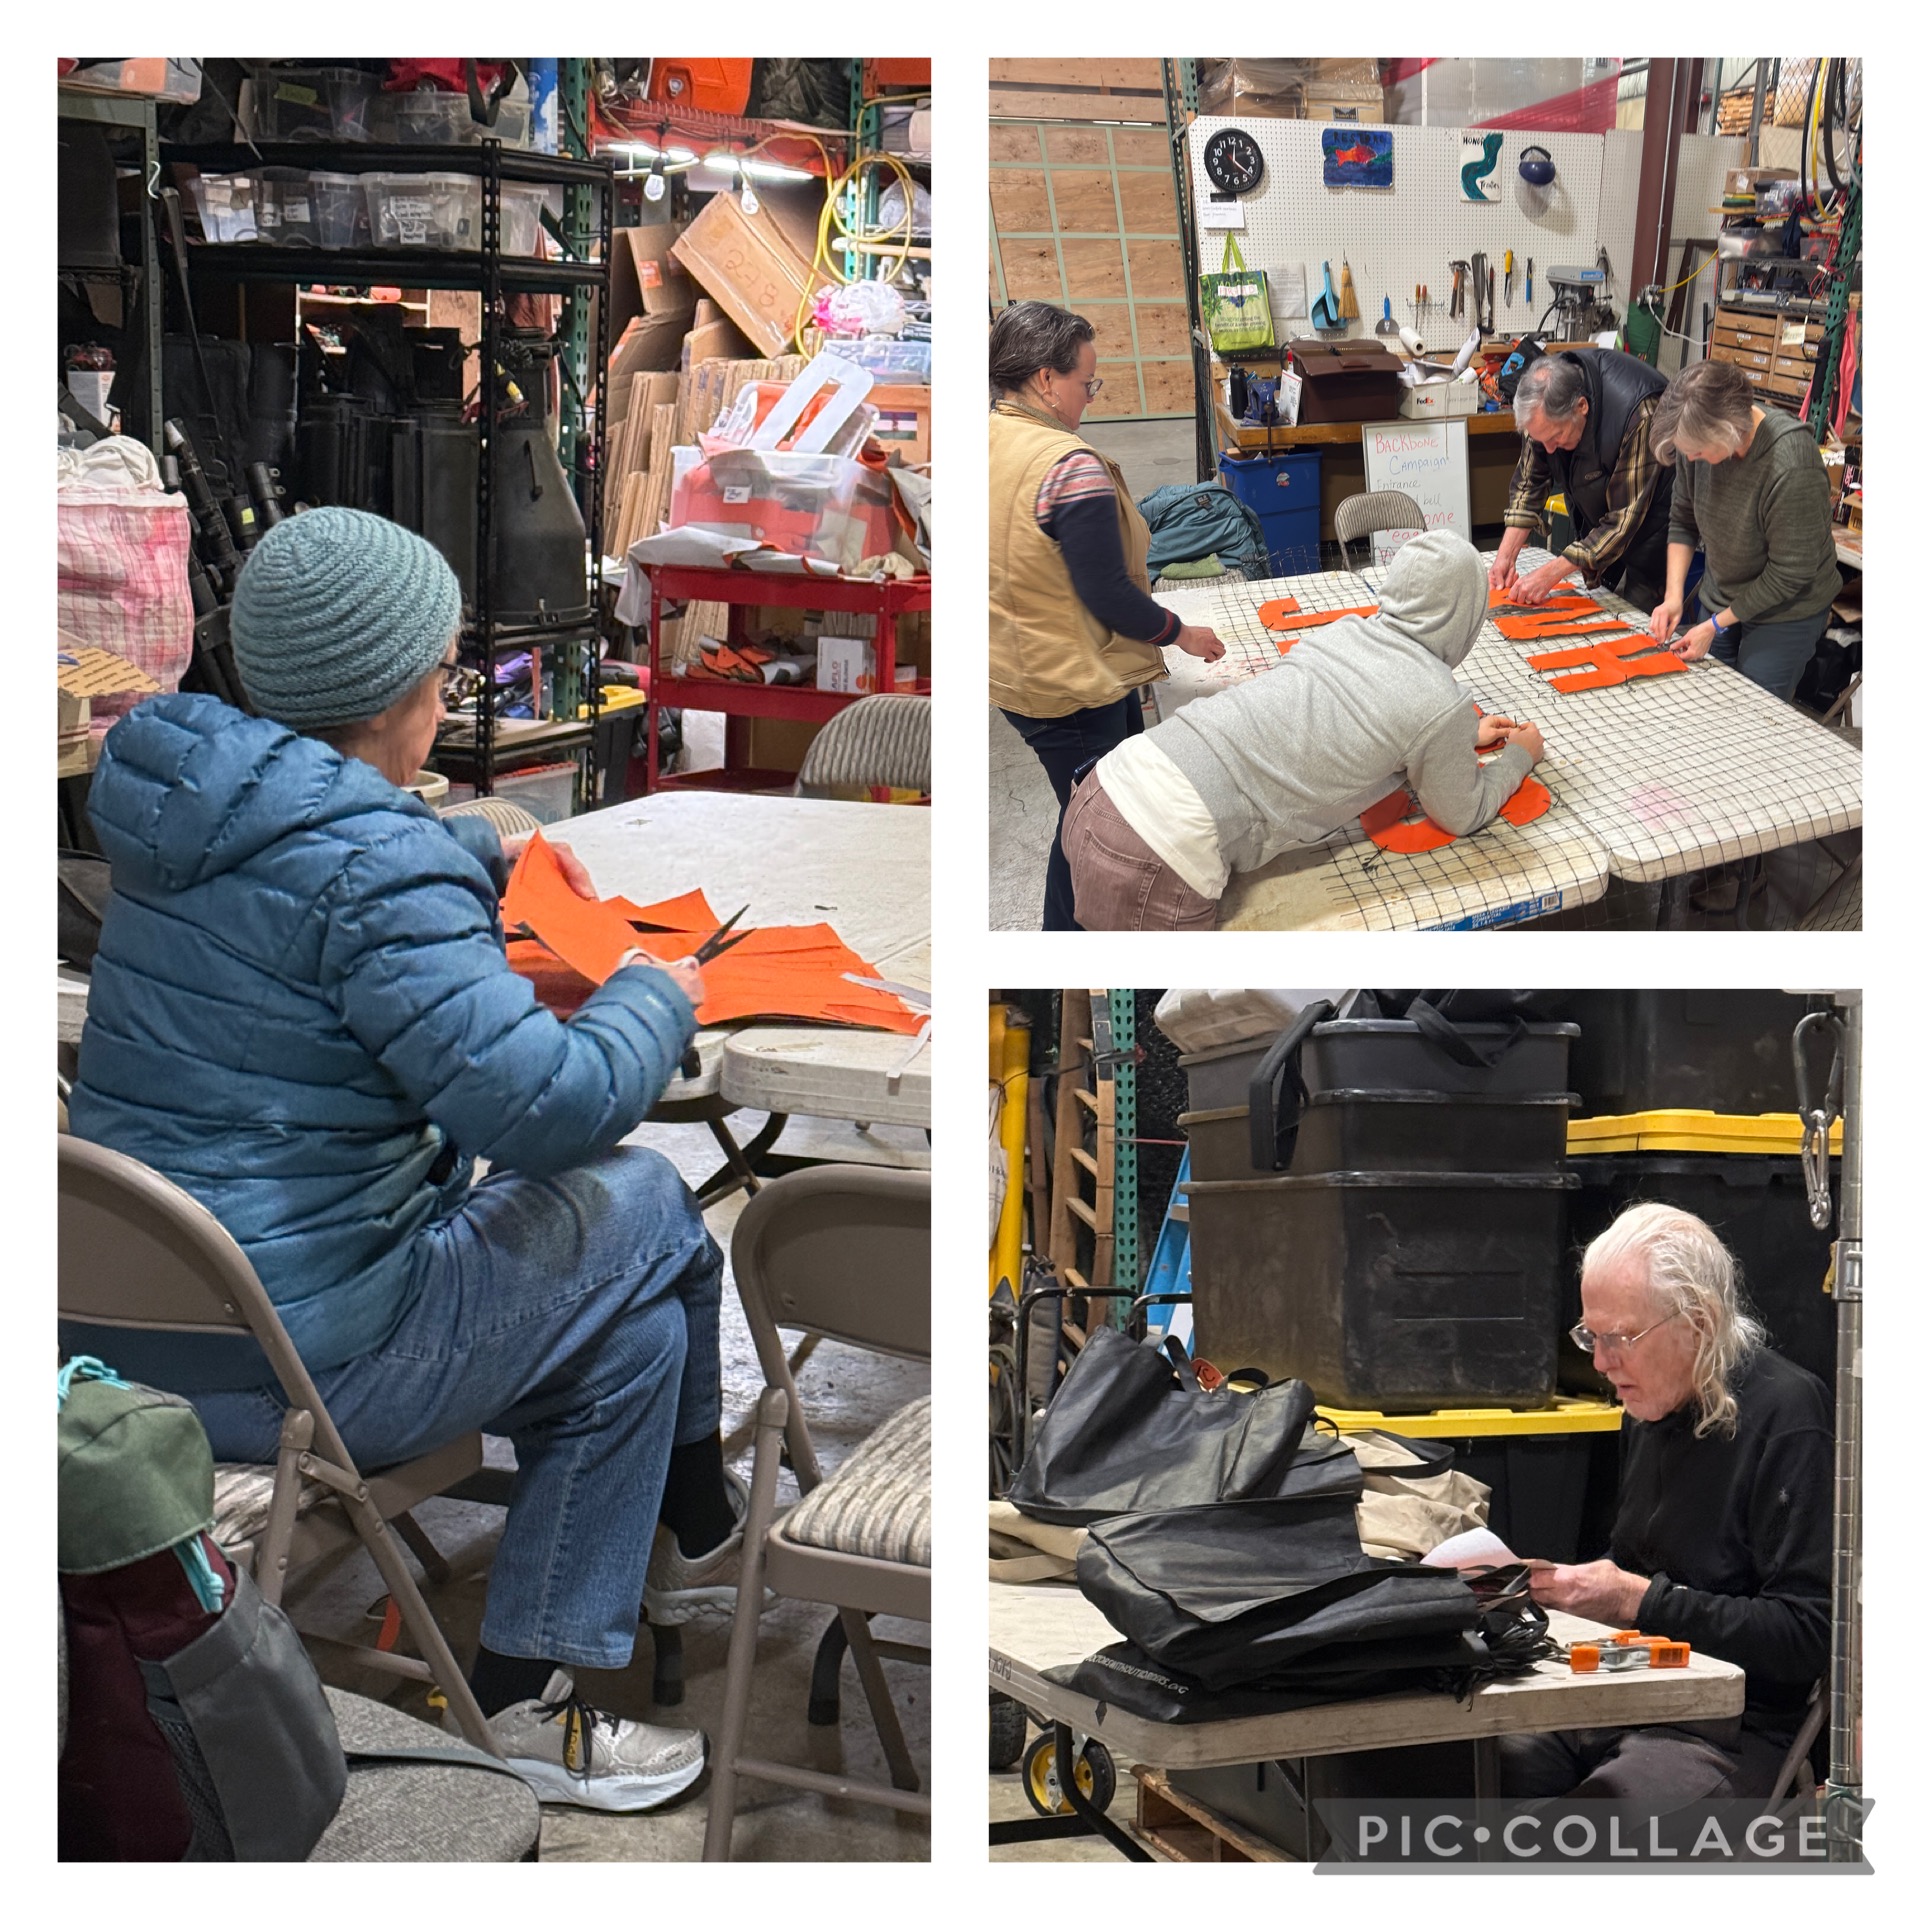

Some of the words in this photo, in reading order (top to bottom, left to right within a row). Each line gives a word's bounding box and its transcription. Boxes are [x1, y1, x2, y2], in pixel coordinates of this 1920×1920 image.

[1219, 140, 1226, 149] 11
[1227, 136, 1236, 146] 12
[1239, 139, 1243, 148] 1
[1214, 147, 1222, 157] 10
[1246, 146, 1251, 156] 2
[1213, 157, 1218, 166] 9
[1250, 156, 1255, 165] 3
[1216, 166, 1222, 176] 8
[1248, 166, 1253, 175] 4
[1224, 174, 1230, 183] 7
[1233, 176, 1240, 185] 6
[1242, 173, 1248, 183] 5
[1416, 396, 1435, 405] FedEx
